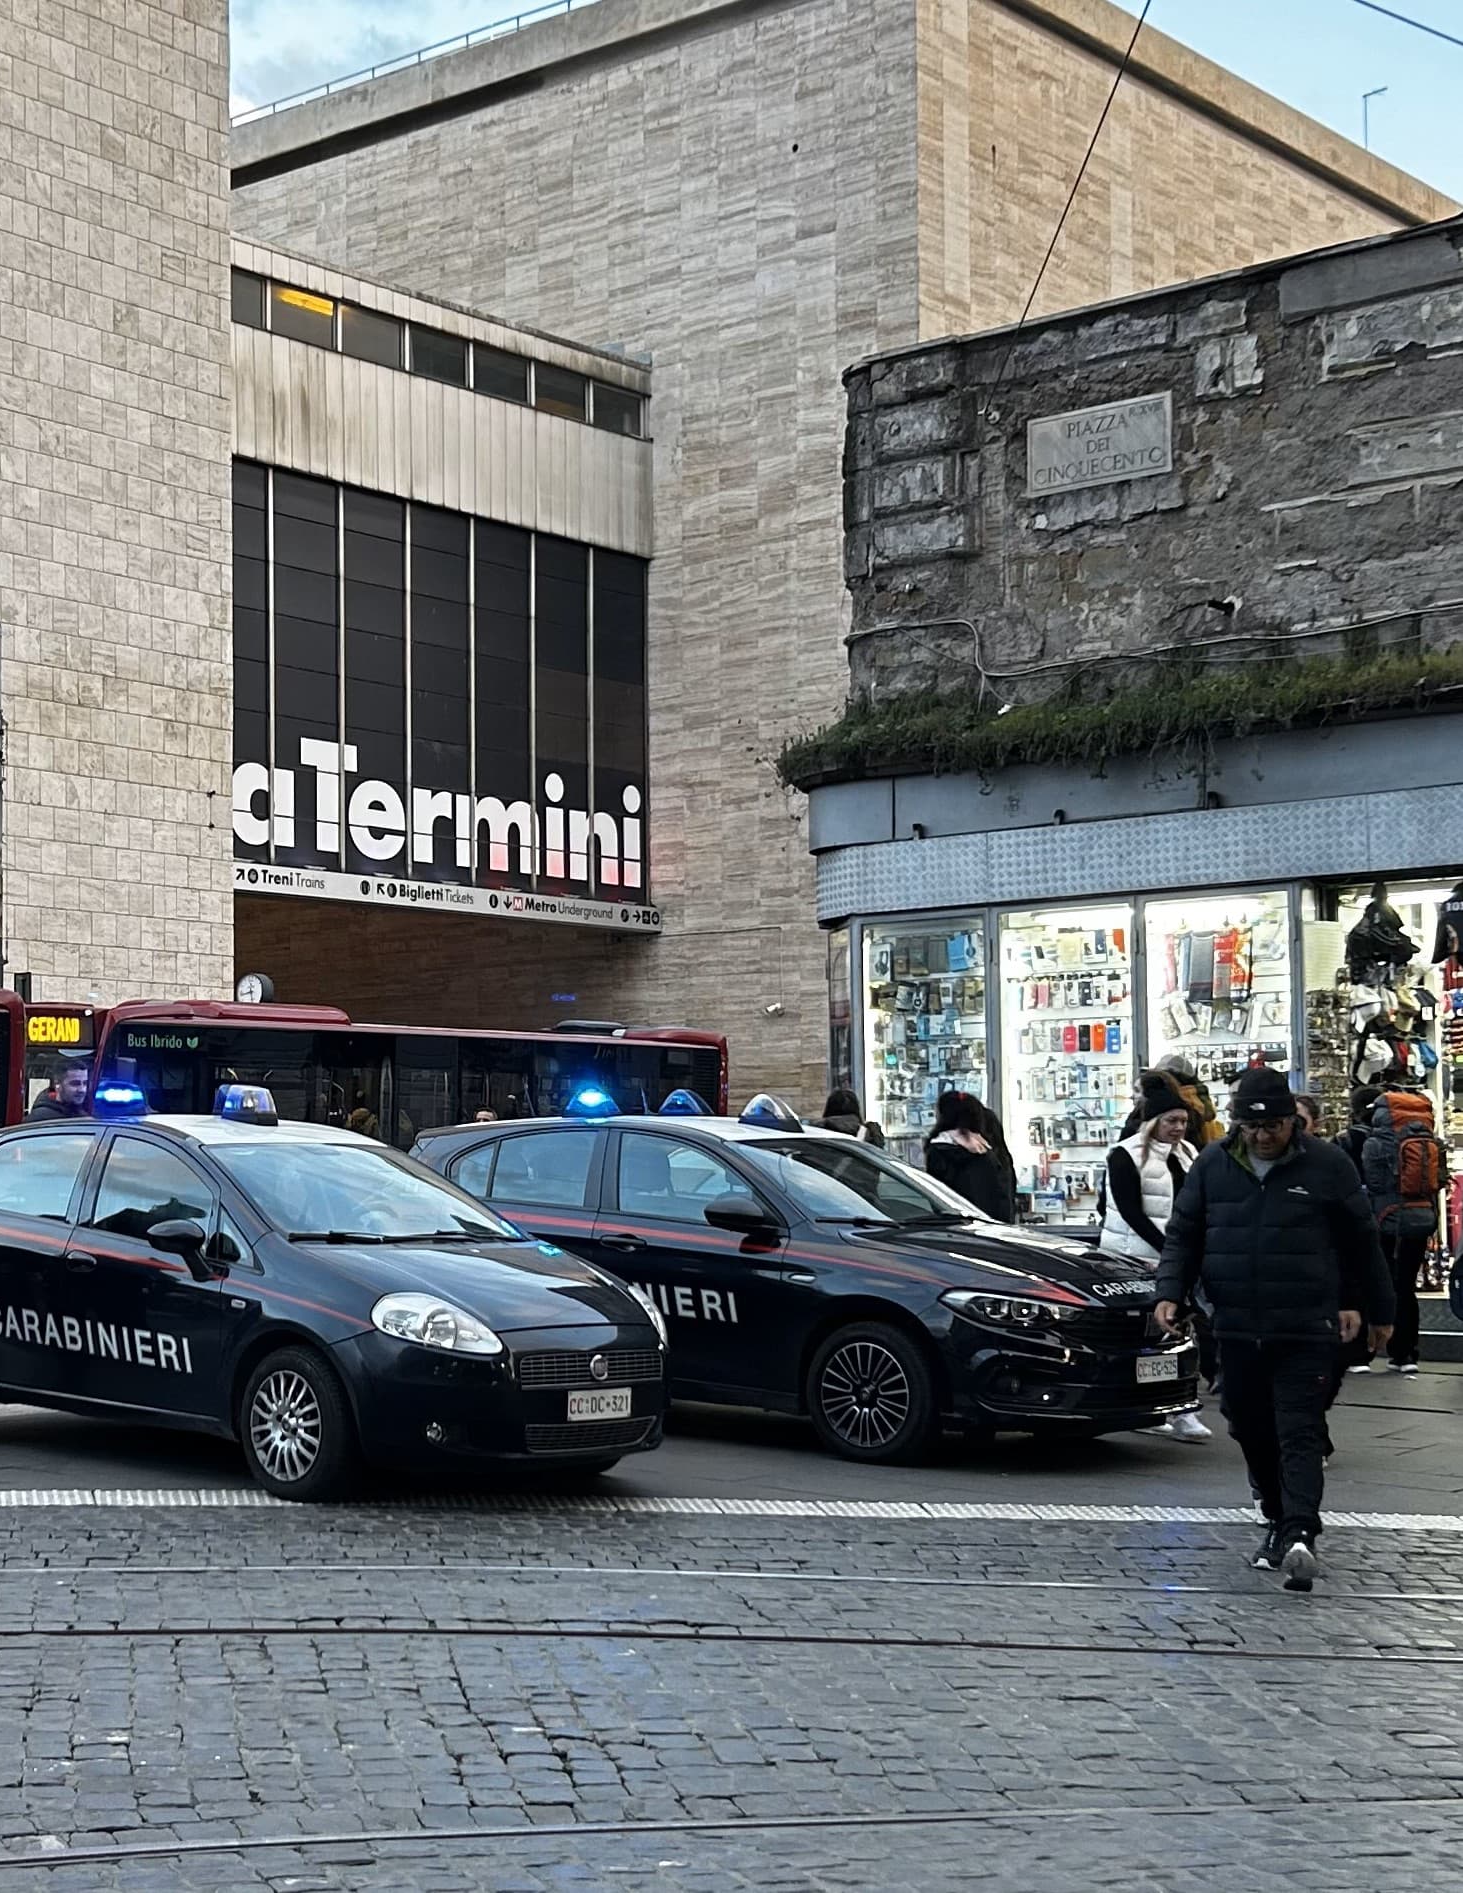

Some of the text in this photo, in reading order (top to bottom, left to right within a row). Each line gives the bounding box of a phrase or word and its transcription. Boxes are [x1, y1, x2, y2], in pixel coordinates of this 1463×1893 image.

[1067, 413, 1129, 439] PIAZZA
[1086, 436, 1111, 454] DEI
[1033, 446, 1164, 486] CINQUECENTO
[261, 868, 325, 890] Treni Trains
[399, 883, 474, 905] Biglietti Tickets
[524, 898, 557, 913] Metro
[558, 905, 613, 920] Underground
[127, 1033, 182, 1049] Bus Ibrido
